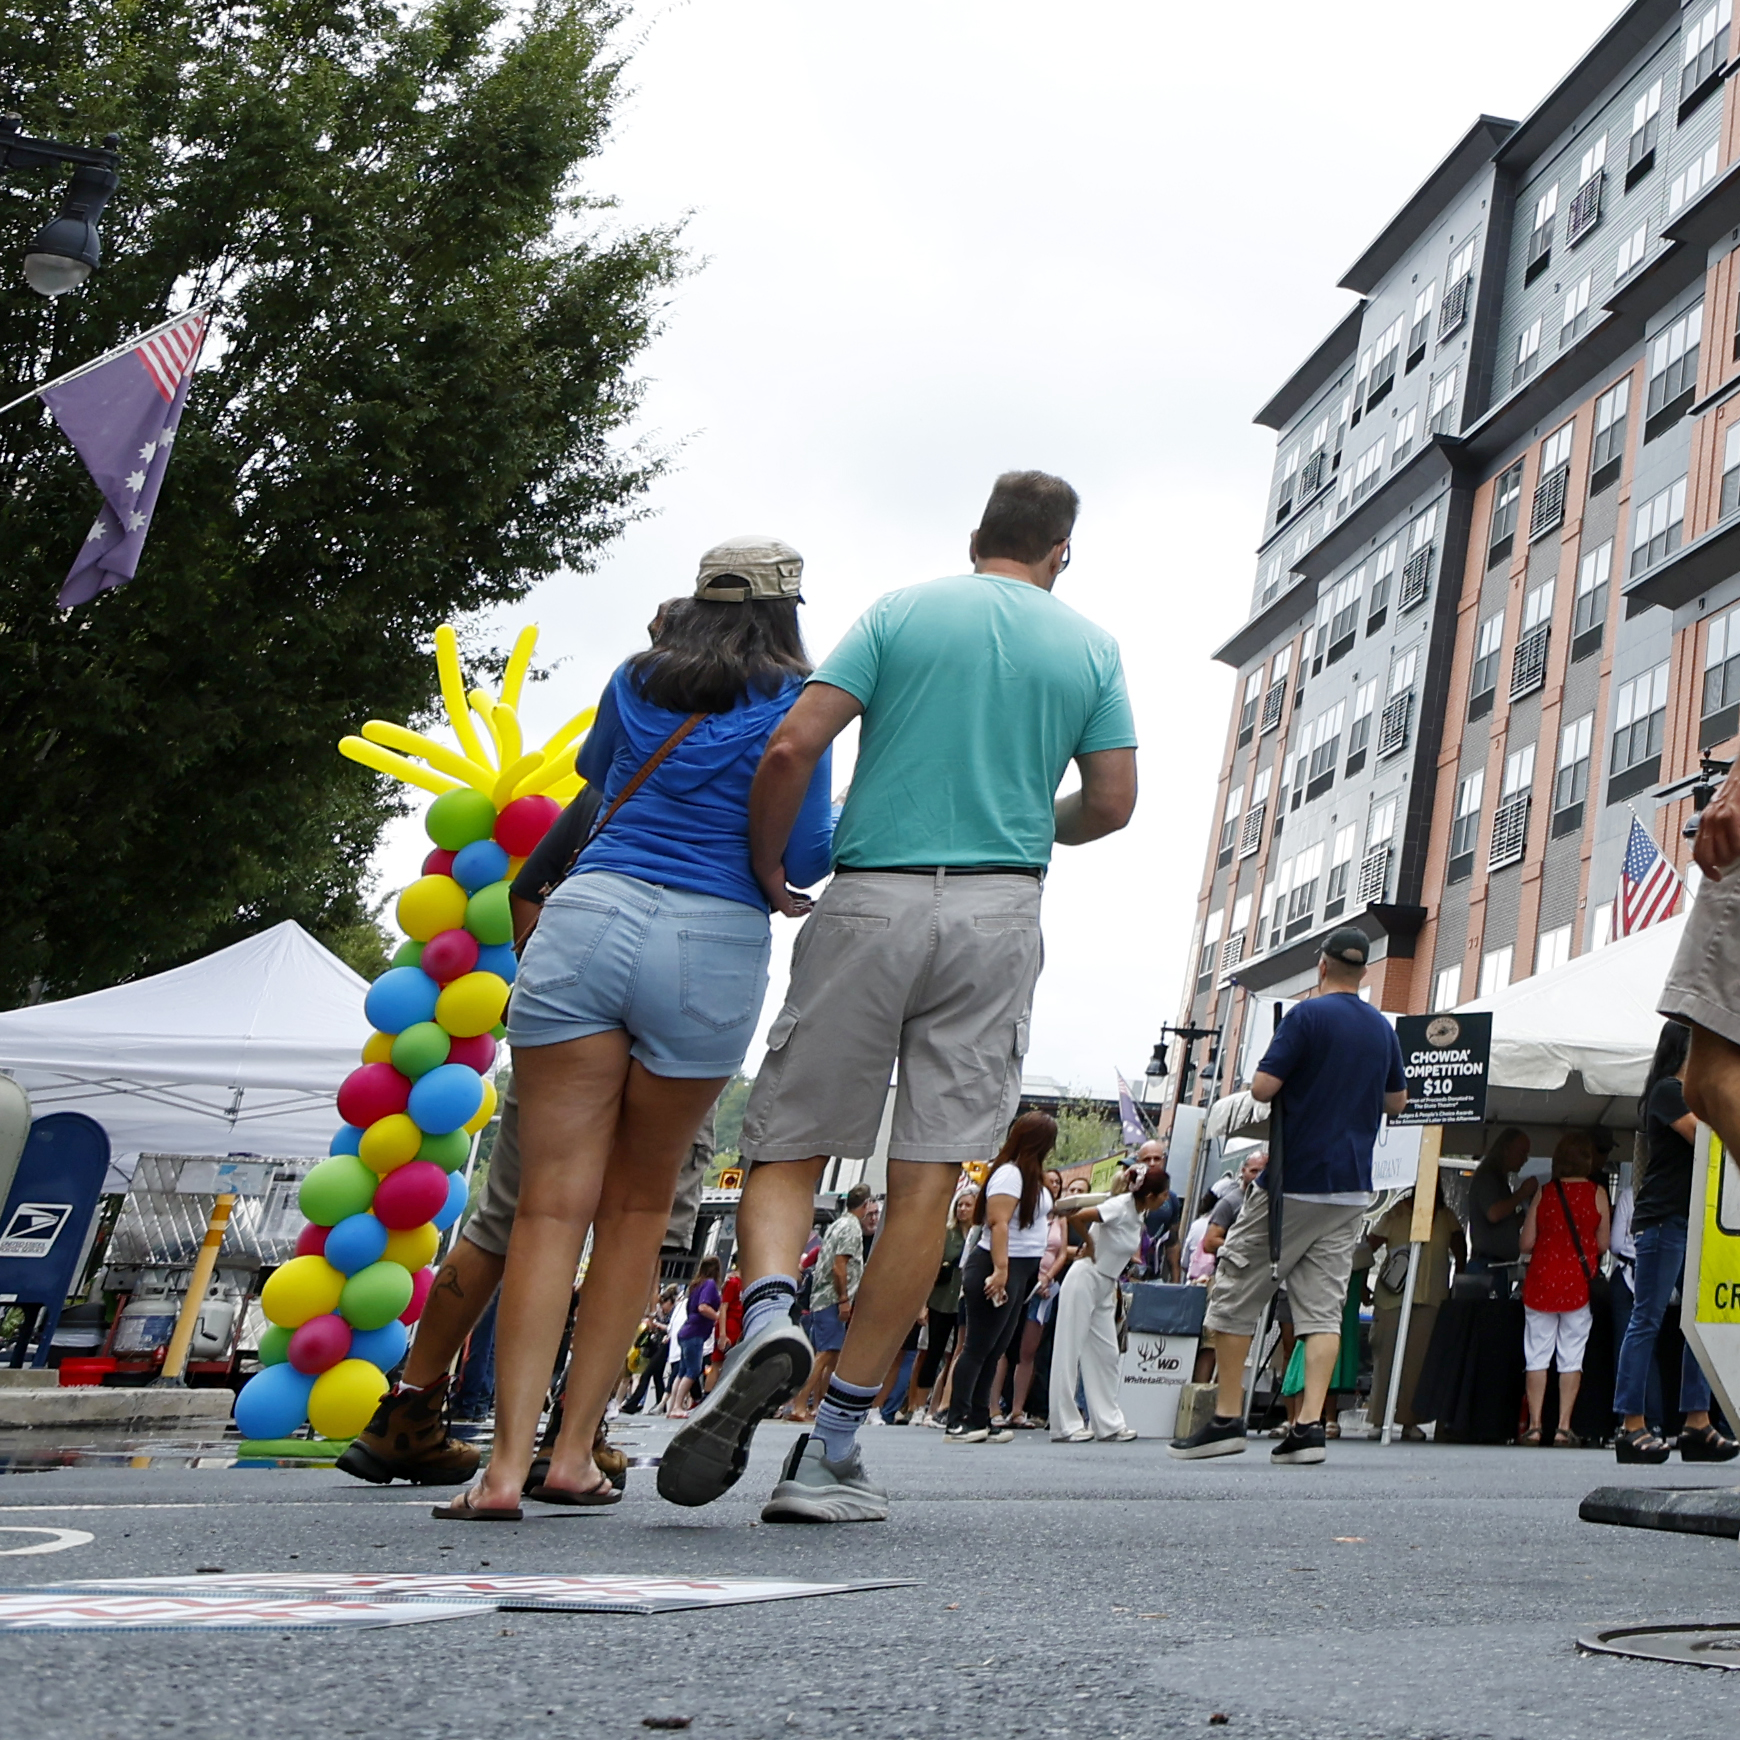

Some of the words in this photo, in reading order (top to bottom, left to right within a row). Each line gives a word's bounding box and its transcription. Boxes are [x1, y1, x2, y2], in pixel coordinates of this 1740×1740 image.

[1410, 1048, 1472, 1064] CHOWDA'
[1403, 1062, 1483, 1078] OMPETITION
[1422, 1078, 1453, 1097] $10
